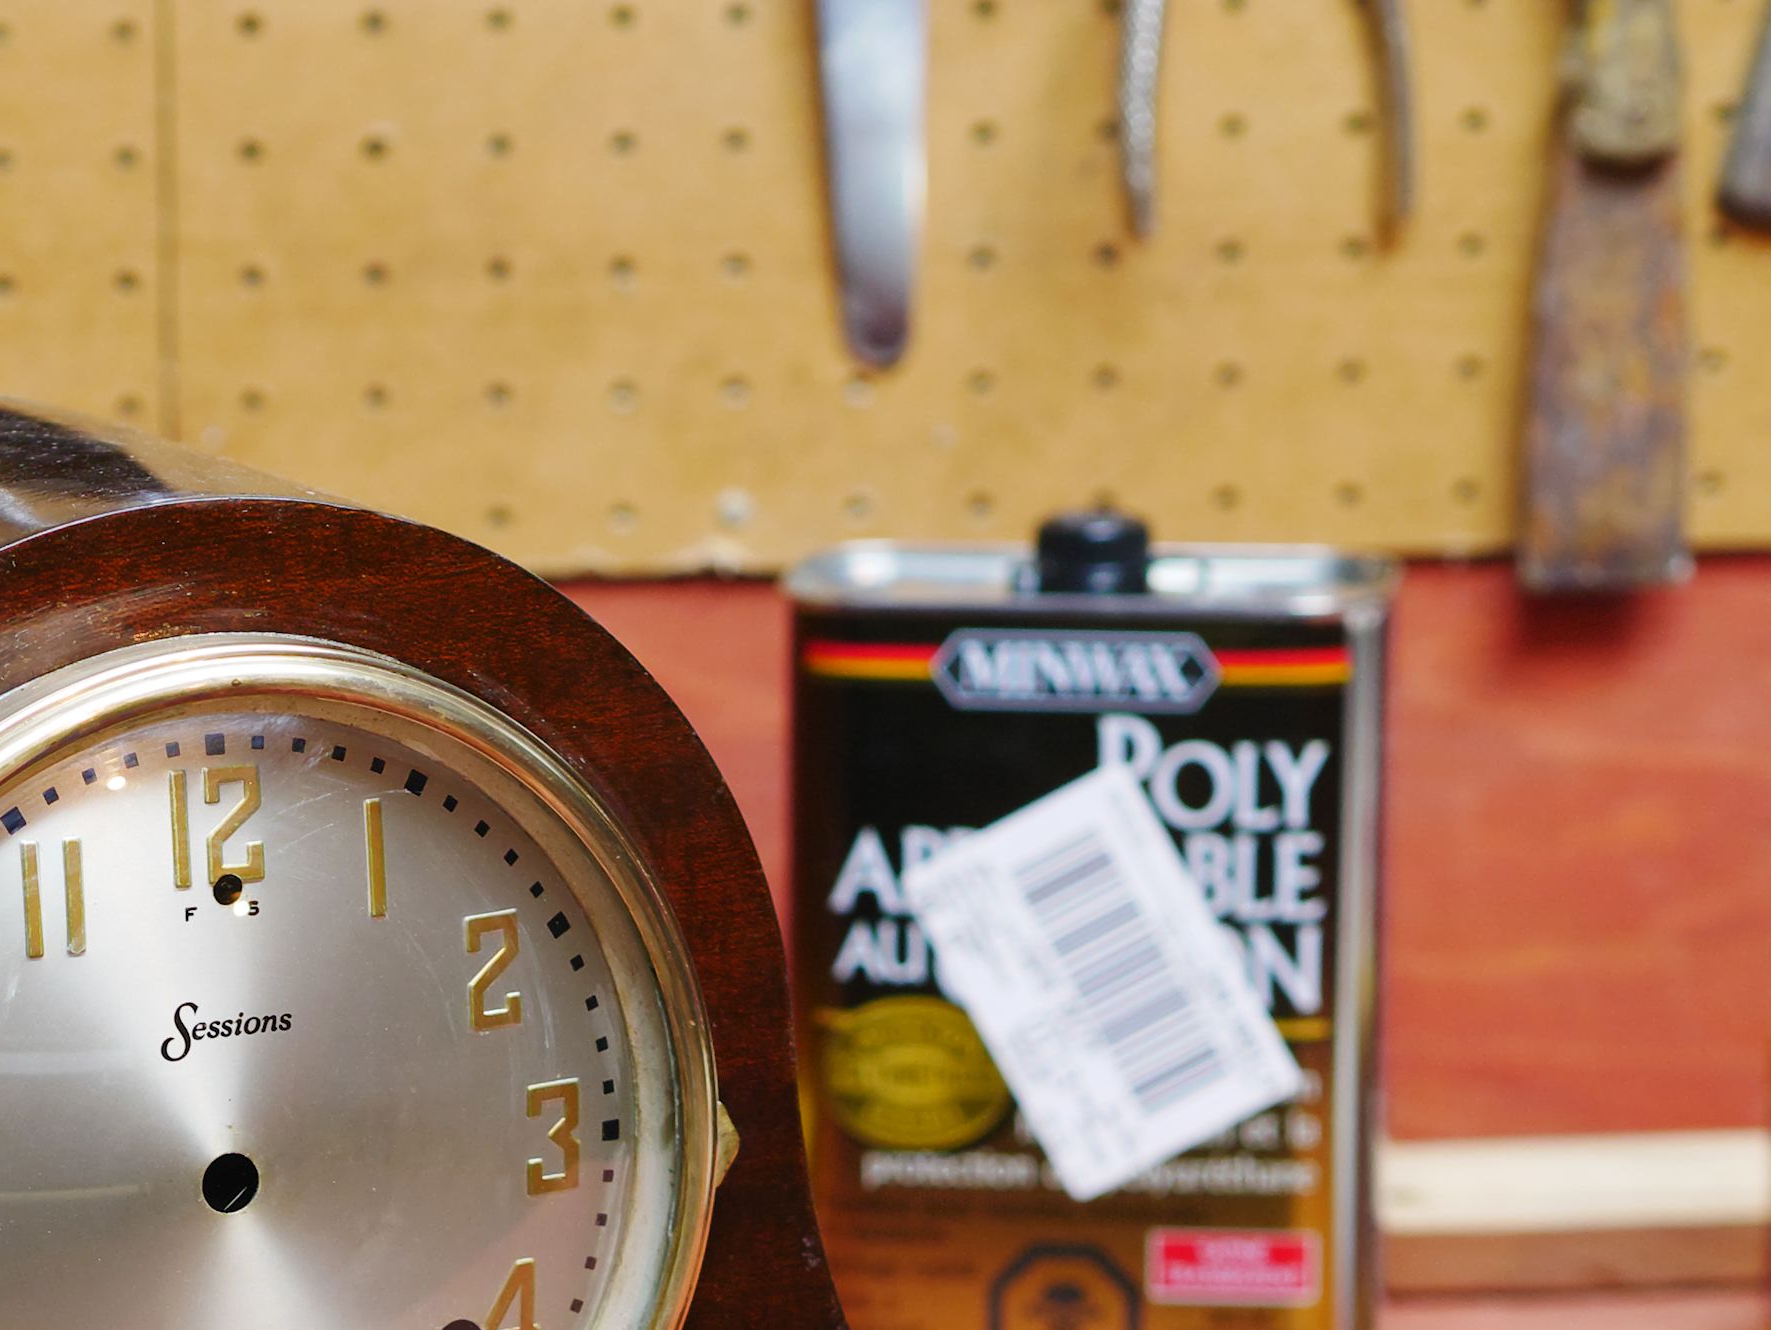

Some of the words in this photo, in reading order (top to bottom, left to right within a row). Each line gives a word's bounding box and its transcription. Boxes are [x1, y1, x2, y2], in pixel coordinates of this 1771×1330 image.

[167, 763, 267, 890] 12
[1096, 712, 1330, 832] POLY
[21, 836, 88, 959] 11
[185, 906, 198, 922] F
[363, 798, 387, 919] 1
[463, 908, 521, 1032] 2
[831, 918, 927, 985] AU
[160, 1002, 293, 1062] Sessions
[525, 1077, 581, 1197] 3
